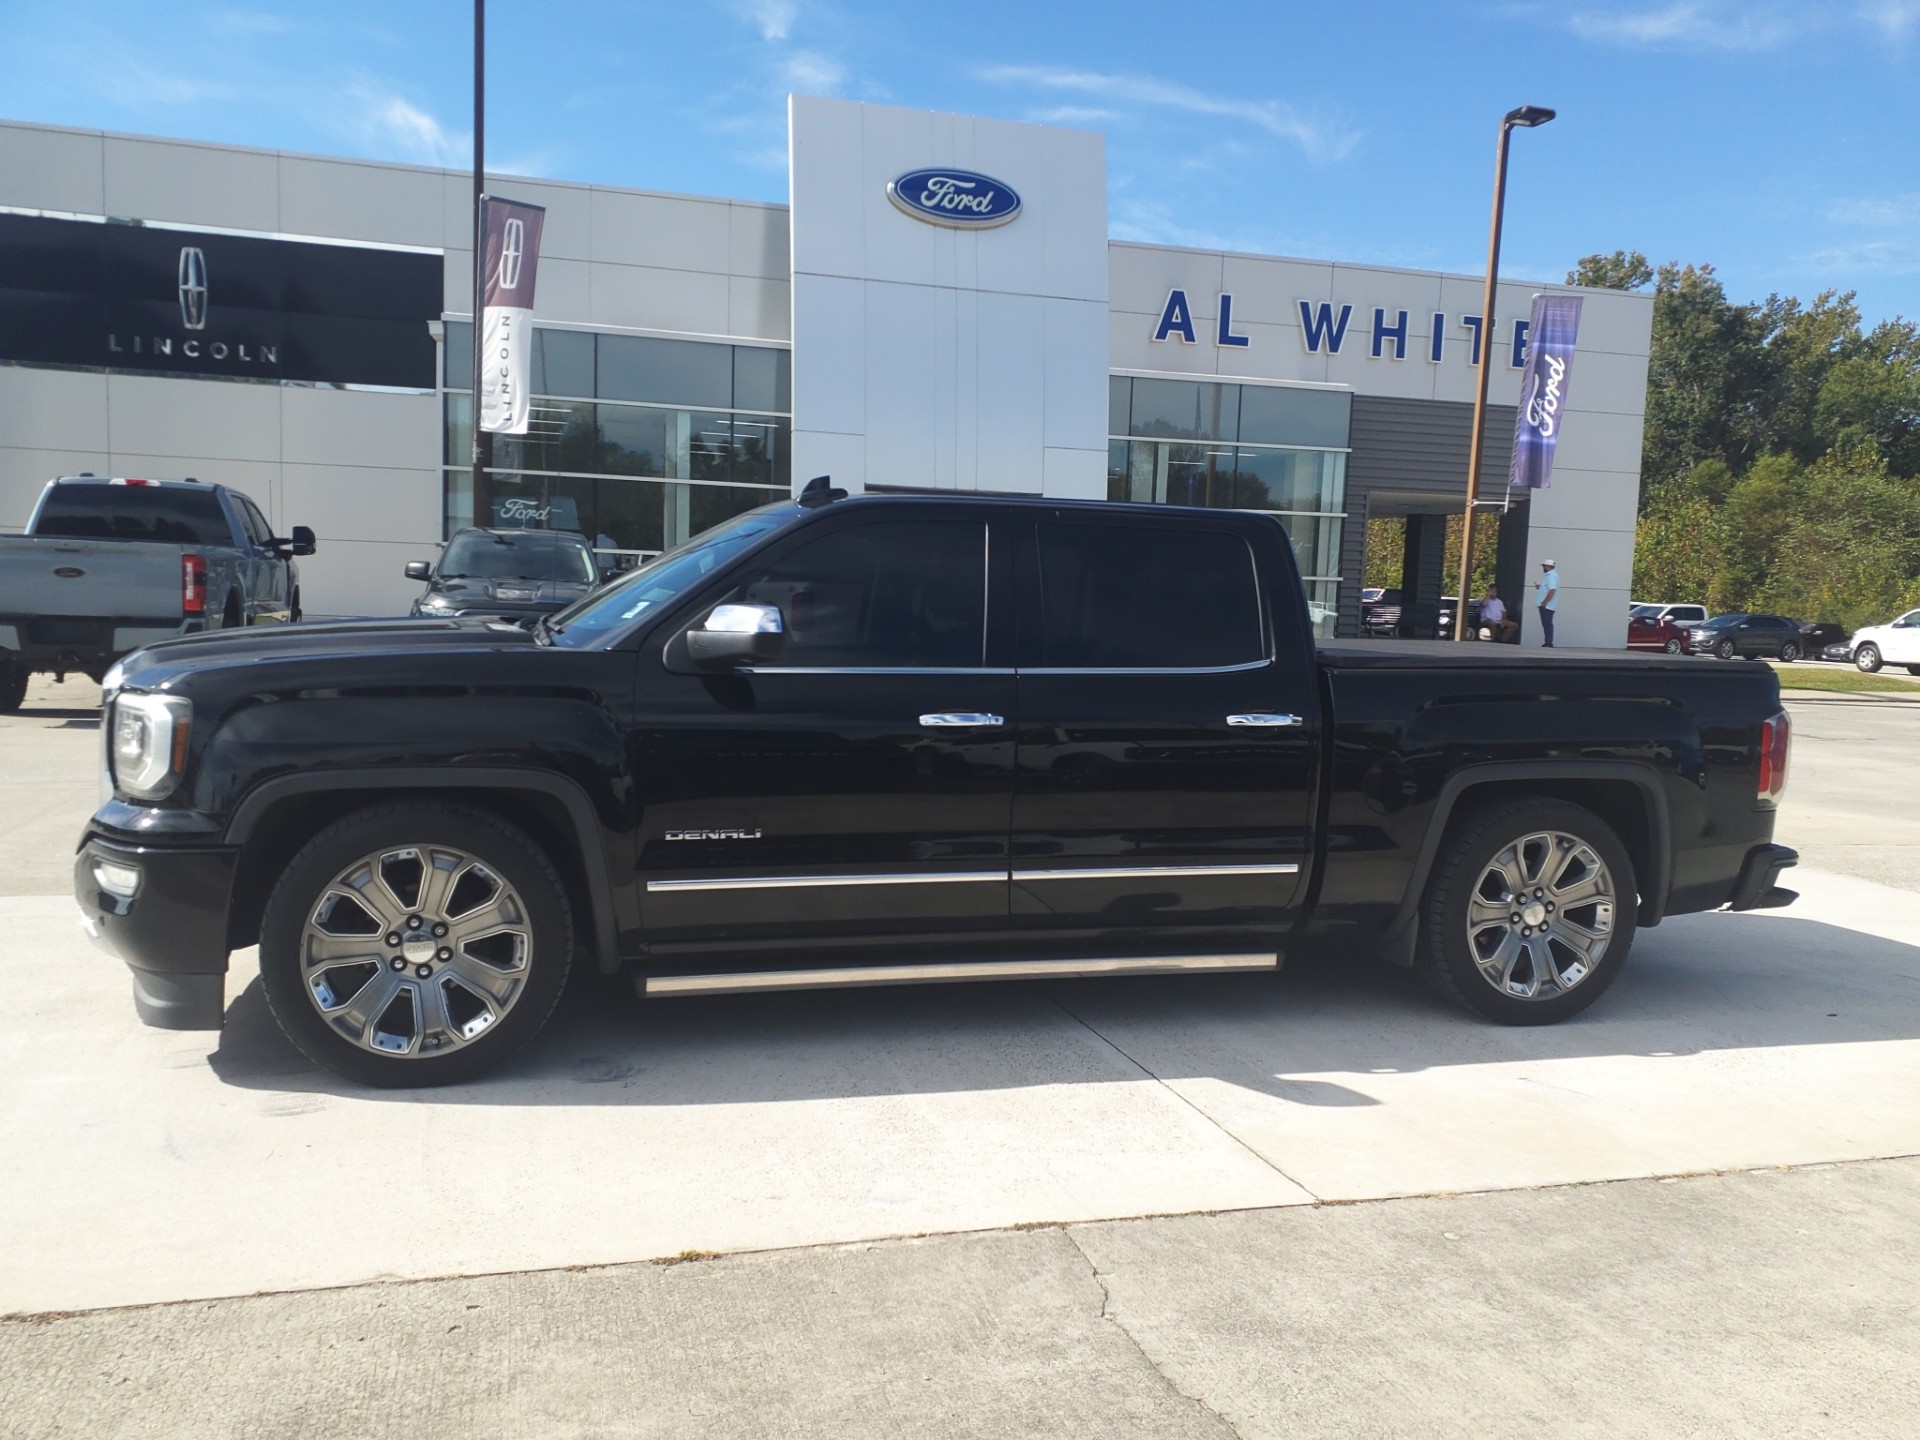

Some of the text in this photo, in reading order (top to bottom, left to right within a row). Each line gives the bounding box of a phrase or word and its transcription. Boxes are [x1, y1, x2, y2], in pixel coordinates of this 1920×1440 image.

[920, 177, 994, 213] Ford
[1153, 288, 1530, 369] AL WHITE
[109, 334, 277, 363] LINCOLN
[500, 315, 512, 422] LINCOLN
[1527, 353, 1566, 437] Ford
[500, 498, 551, 520] Ford
[664, 828, 762, 840] DENALI
